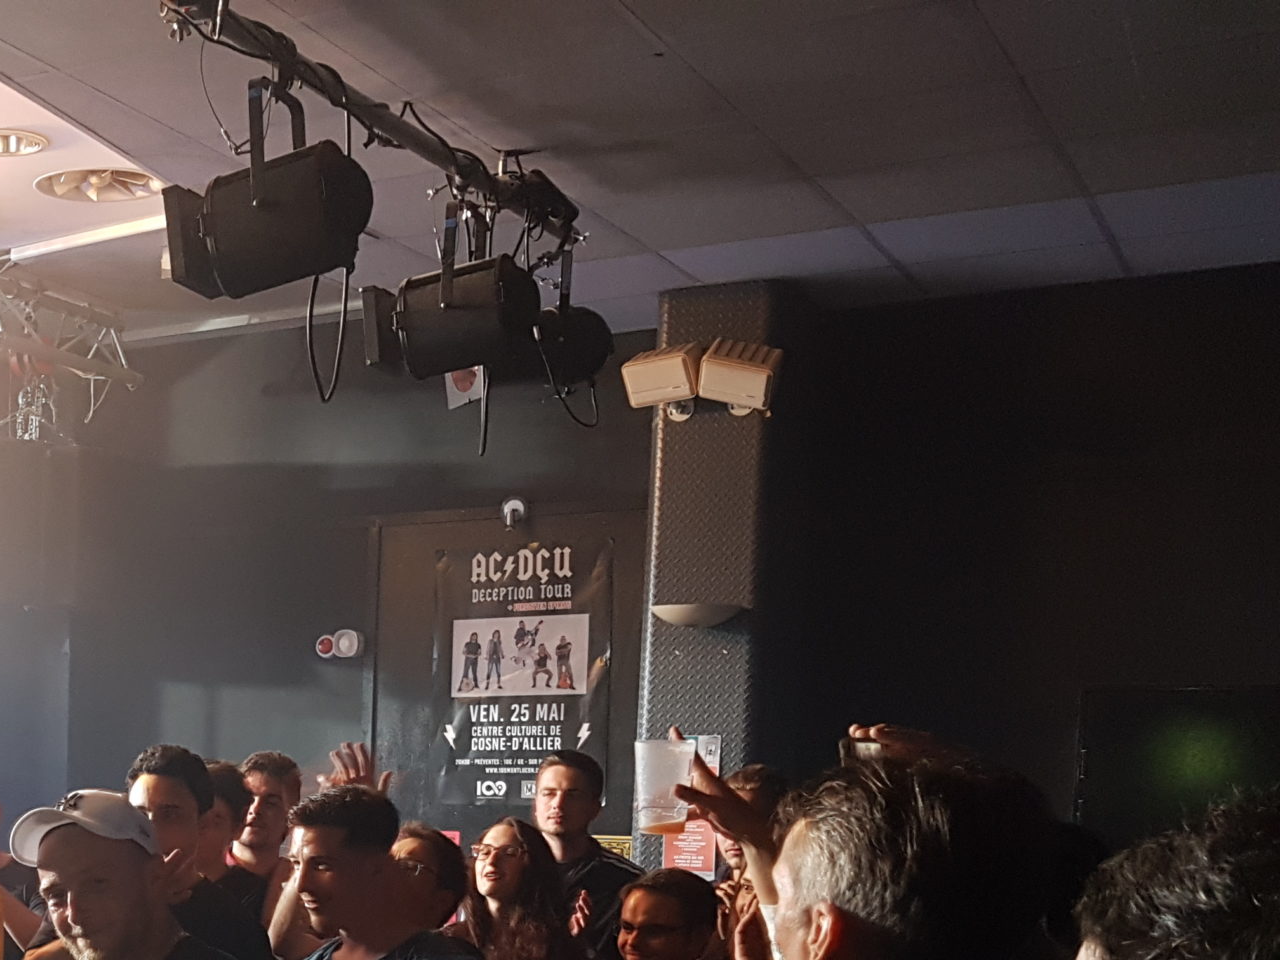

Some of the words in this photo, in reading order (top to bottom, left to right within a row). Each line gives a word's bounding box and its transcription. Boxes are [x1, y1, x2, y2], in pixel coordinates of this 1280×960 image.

[472, 586, 533, 603] DECEPTION
[540, 583, 572, 599] TOUR
[469, 704, 504, 722] VEN.
[510, 703, 529, 722] 25
[535, 703, 565, 721] MAI
[471, 725, 503, 737] CENTRE
[505, 725, 548, 736] CULTUREL
[550, 725, 562, 735] DE
[471, 737, 562, 751] COSNE-D'ALLIER
